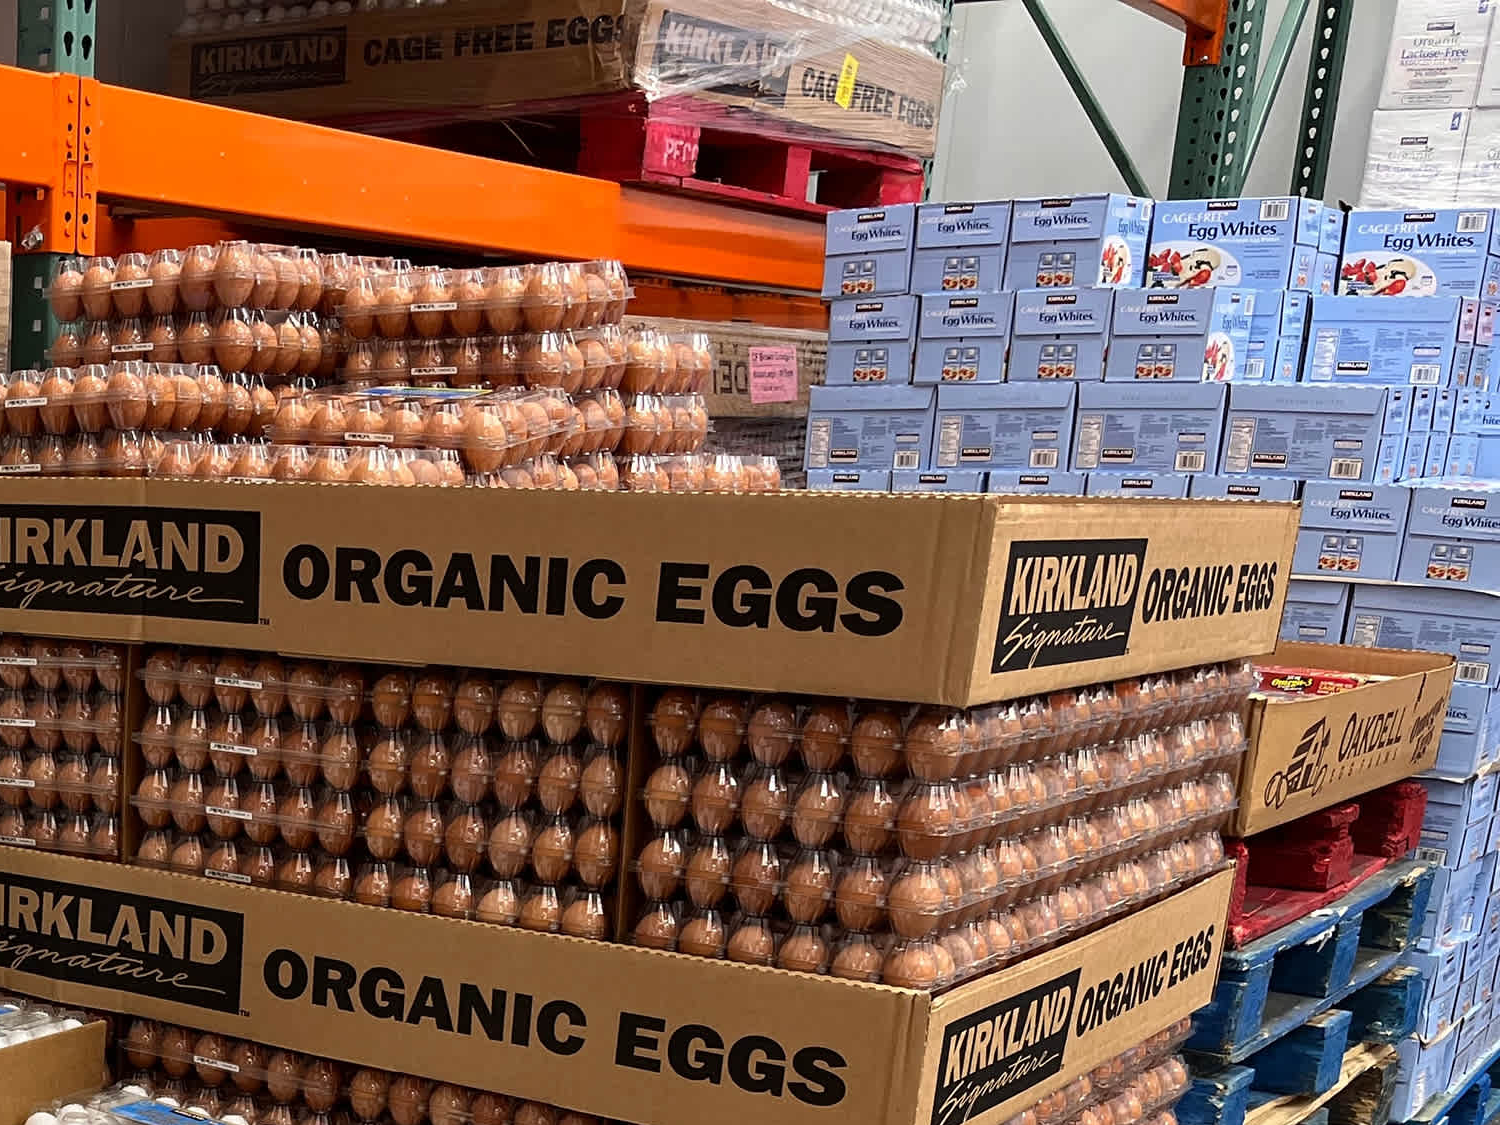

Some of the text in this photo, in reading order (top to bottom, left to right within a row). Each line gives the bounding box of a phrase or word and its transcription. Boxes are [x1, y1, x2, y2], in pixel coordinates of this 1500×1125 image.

[363, 14, 626, 66] CAGE FREE EGGS
[200, 38, 340, 75] KIRKLAND
[801, 66, 840, 104] CAG
[851, 80, 894, 117] FREE
[898, 94, 935, 130] EGGS
[937, 220, 990, 233] Egg Whites
[1033, 214, 1089, 227] Egg Whites
[851, 227, 901, 242] Egg Whites
[1187, 221, 1277, 241] Egg Whites
[1383, 233, 1475, 251] Egg Whites
[849, 318, 900, 331] Egg Whites
[942, 315, 995, 327] Egg Whites
[1038, 311, 1093, 323] Egg Whites
[1139, 311, 1196, 324] Egg Whites
[1330, 507, 1391, 520] Egg Whites
[1441, 514, 1463, 528] Egg
[281, 543, 905, 637] ORGANIC EGGS
[1011, 551, 1140, 617] KIRKLAND
[1143, 561, 1279, 625] ORGANIC EGGS
[1000, 617, 1126, 666] Signature
[1271, 678, 1313, 688] Omega-3
[1445, 707, 1468, 720] ites
[1337, 706, 1408, 763] OAKDELL
[1076, 924, 1215, 1039] ORGANIC EGGS
[263, 948, 847, 1107] ORGANIC EGGS
[943, 985, 1073, 1088] KIRKLAND
